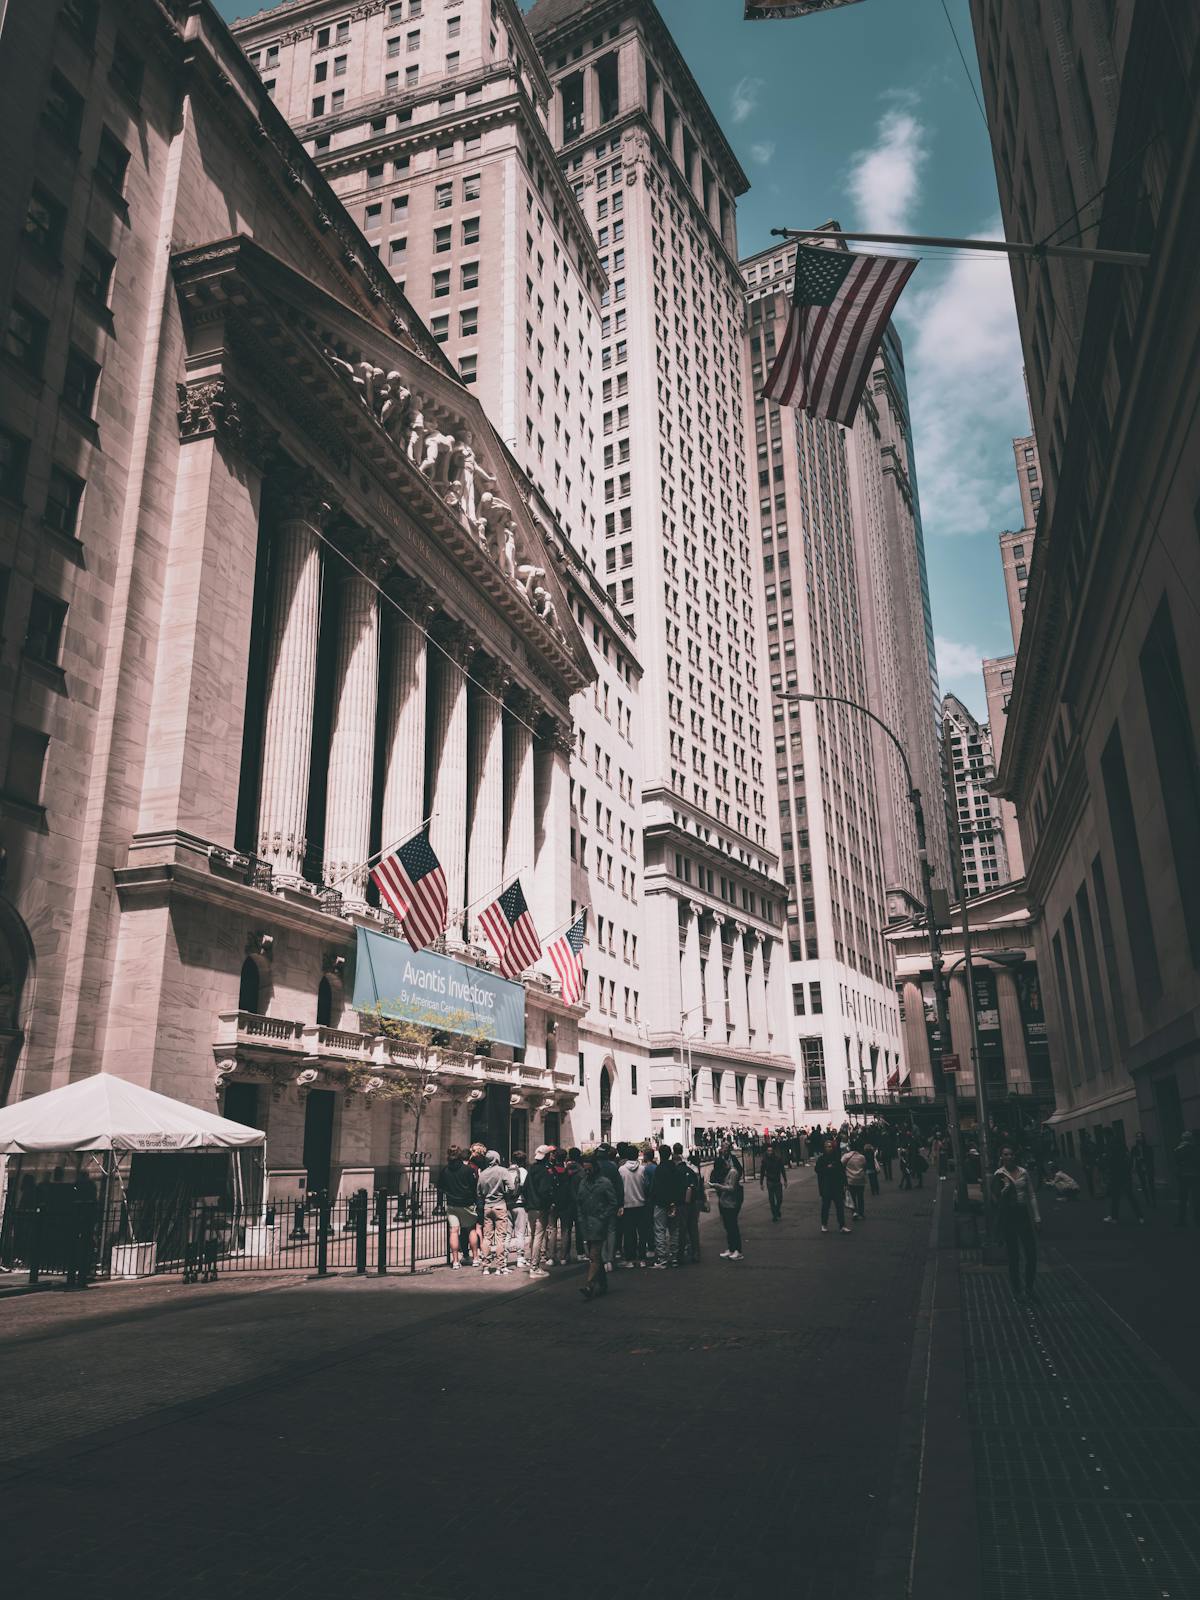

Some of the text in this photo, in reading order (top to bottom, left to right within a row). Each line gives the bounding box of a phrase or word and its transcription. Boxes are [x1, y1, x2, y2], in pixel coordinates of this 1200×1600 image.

[400, 990, 410, 1005] By
[411, 993, 440, 1011] American
[402, 960, 495, 1009] Avantis Investors
